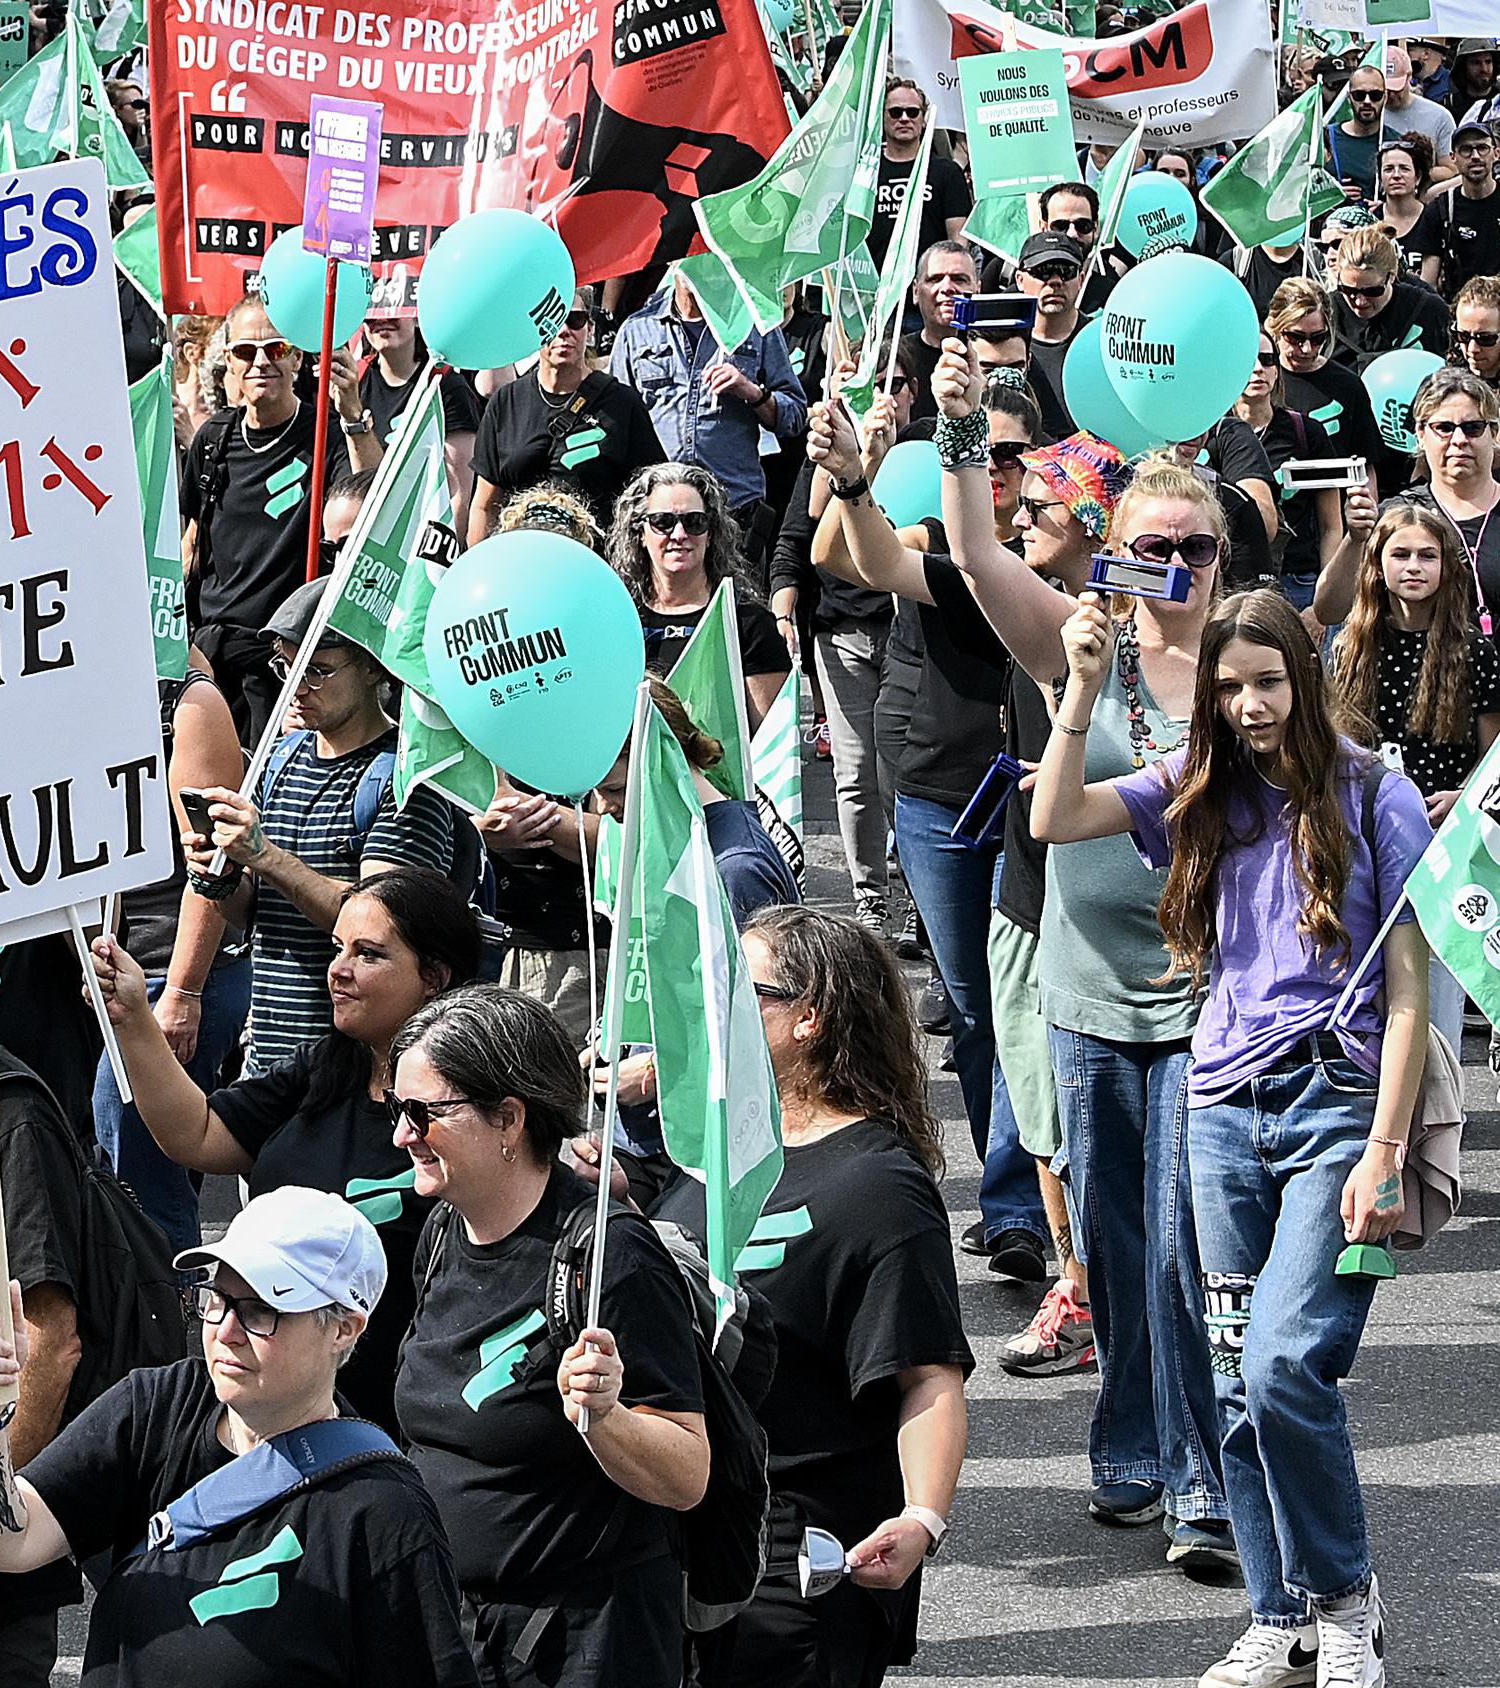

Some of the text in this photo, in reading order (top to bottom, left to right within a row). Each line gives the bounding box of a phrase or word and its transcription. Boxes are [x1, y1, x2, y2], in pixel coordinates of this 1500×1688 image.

[178, 0, 323, 40] SYNDICAT
[334, 12, 390, 48] DES
[615, 8, 717, 59] COMMUN
[177, 7, 598, 96] DU CÉGEP DU VIEUX MONTRÉAL
[997, 66, 1027, 82] NOUS
[979, 84, 1050, 104] VOULONS DES
[1128, 103, 1144, 121] et
[1148, 88, 1239, 120] professeurs
[1019, 103, 1055, 117] PUBLICS
[194, 121, 258, 146] POUR
[990, 117, 1049, 138] DE QUALITÉ.
[1137, 207, 1168, 228] FRONT
[199, 224, 258, 247] VERS
[1105, 312, 1147, 341] FRONT
[1108, 336, 1176, 366] COMMUN
[443, 607, 510, 659] FRONT
[459, 626, 567, 686] COMMUN
[300, 1436, 316, 1465] OSPREY
